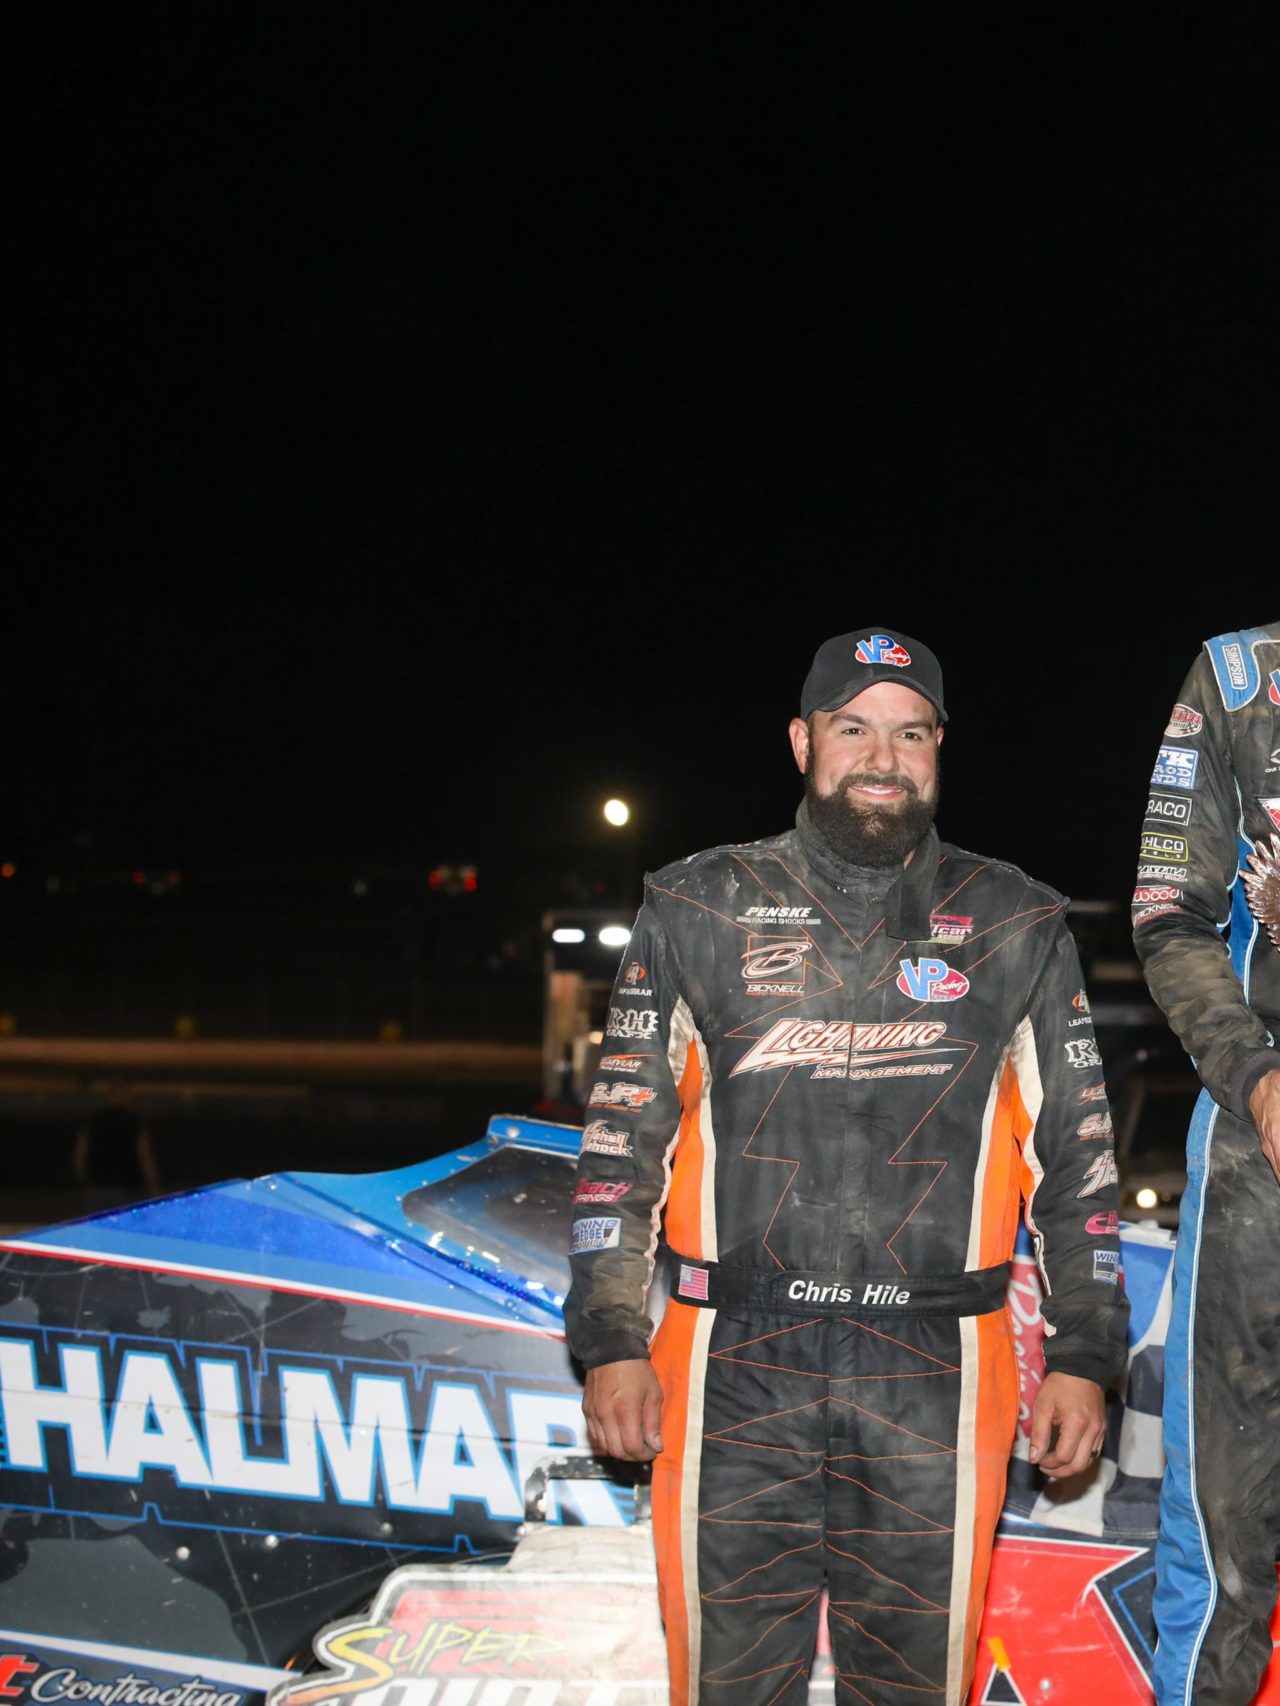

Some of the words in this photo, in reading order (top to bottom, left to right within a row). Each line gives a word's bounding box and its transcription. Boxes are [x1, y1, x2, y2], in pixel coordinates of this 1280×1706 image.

[856, 635, 896, 663] VP
[1225, 645, 1246, 686] SIMPSON
[1142, 836, 1185, 852] HLCO
[745, 906, 814, 918] PENSKE
[751, 916, 778, 925] RACING
[778, 917, 807, 925] SHOCKS
[746, 983, 806, 993] BICKNELL
[899, 957, 949, 1001] VP
[729, 1017, 948, 1079] LIGHTNING
[810, 1063, 954, 1081] MANAGEMENT
[787, 1279, 852, 1303] Chris
[861, 1283, 911, 1305] Hile
[1, 1337, 628, 1527] HALMAR
